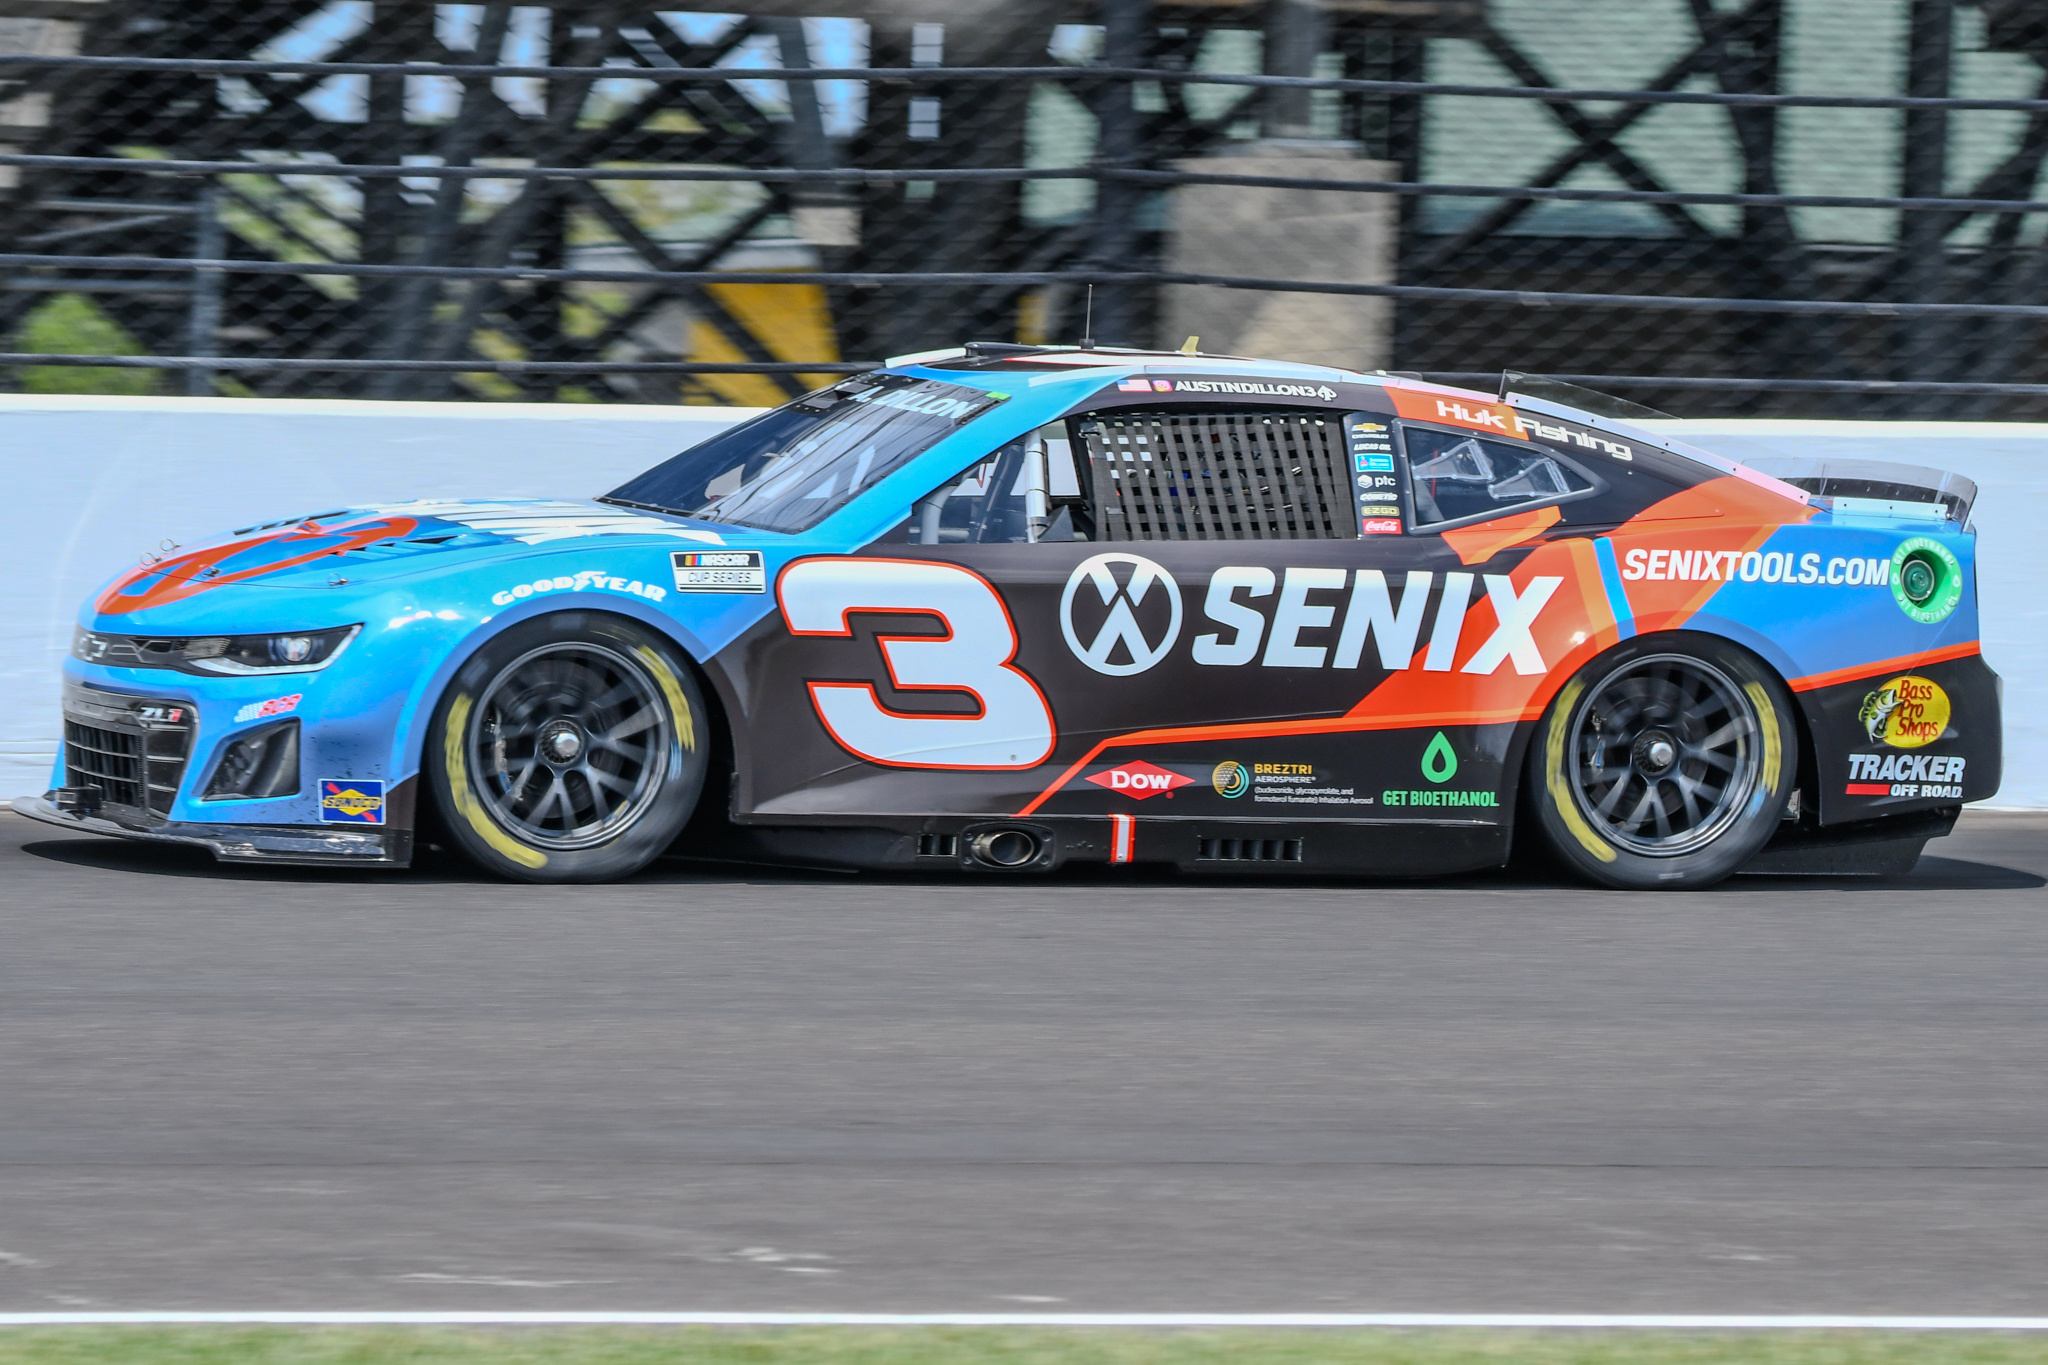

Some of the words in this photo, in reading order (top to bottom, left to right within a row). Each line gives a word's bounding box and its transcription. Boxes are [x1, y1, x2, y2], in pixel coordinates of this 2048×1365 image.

[1175, 380, 1317, 397] AUSTINDILLON3
[849, 386, 885, 403] A.
[872, 390, 979, 418] DILLON
[1436, 400, 1508, 429] Huk
[1513, 416, 1634, 462] Fishing
[1354, 443, 1379, 451] LUCAS
[1374, 475, 1396, 488] ptc
[701, 554, 750, 566] NASCAR
[1622, 548, 1891, 586] SENIXTOOLS.COM
[688, 571, 710, 583] CUP
[713, 571, 751, 583] SERIES
[491, 571, 667, 606] GOODYEAR
[1191, 565, 1565, 677] SENIX
[775, 554, 1057, 770] 3
[1898, 679, 1933, 700] Bass
[138, 707, 184, 722] ZL1
[1897, 699, 1924, 718] Pro
[1895, 716, 1938, 741] Shops
[1254, 763, 1313, 775] BREZTRI
[1848, 753, 1966, 783] TRACKER
[1382, 790, 1408, 807] GET
[1410, 791, 1499, 807] BIOETHANOL
[1890, 784, 1918, 797] OFF
[1921, 785, 1963, 798] ROAD
